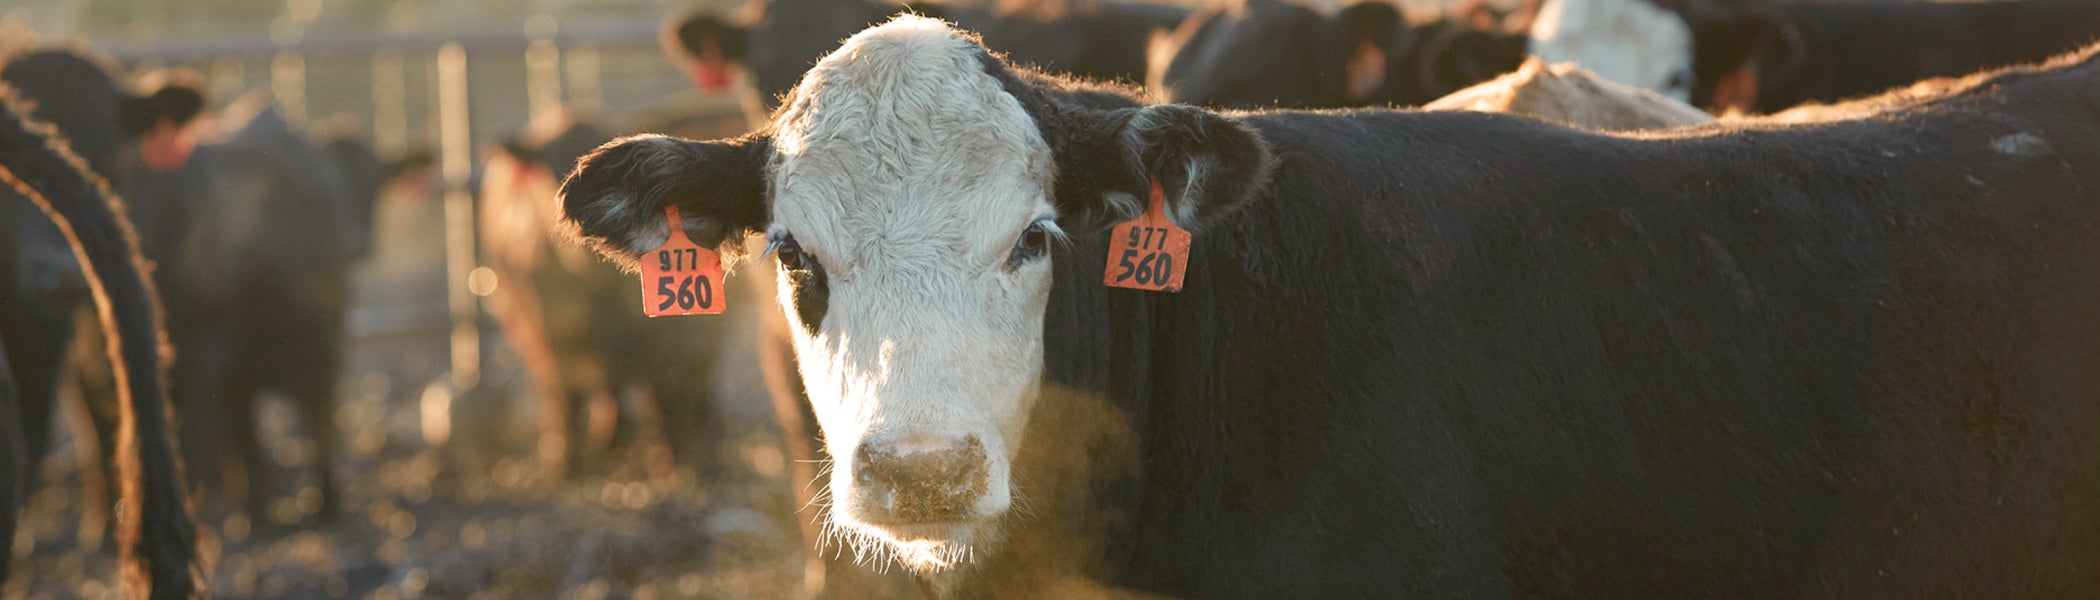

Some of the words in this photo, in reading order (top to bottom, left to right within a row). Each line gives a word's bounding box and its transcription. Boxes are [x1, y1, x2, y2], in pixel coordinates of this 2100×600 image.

[1127, 225, 1169, 250] 977
[658, 248, 698, 272] 977
[1115, 249, 1173, 287] 560
[657, 274, 713, 312] 560
